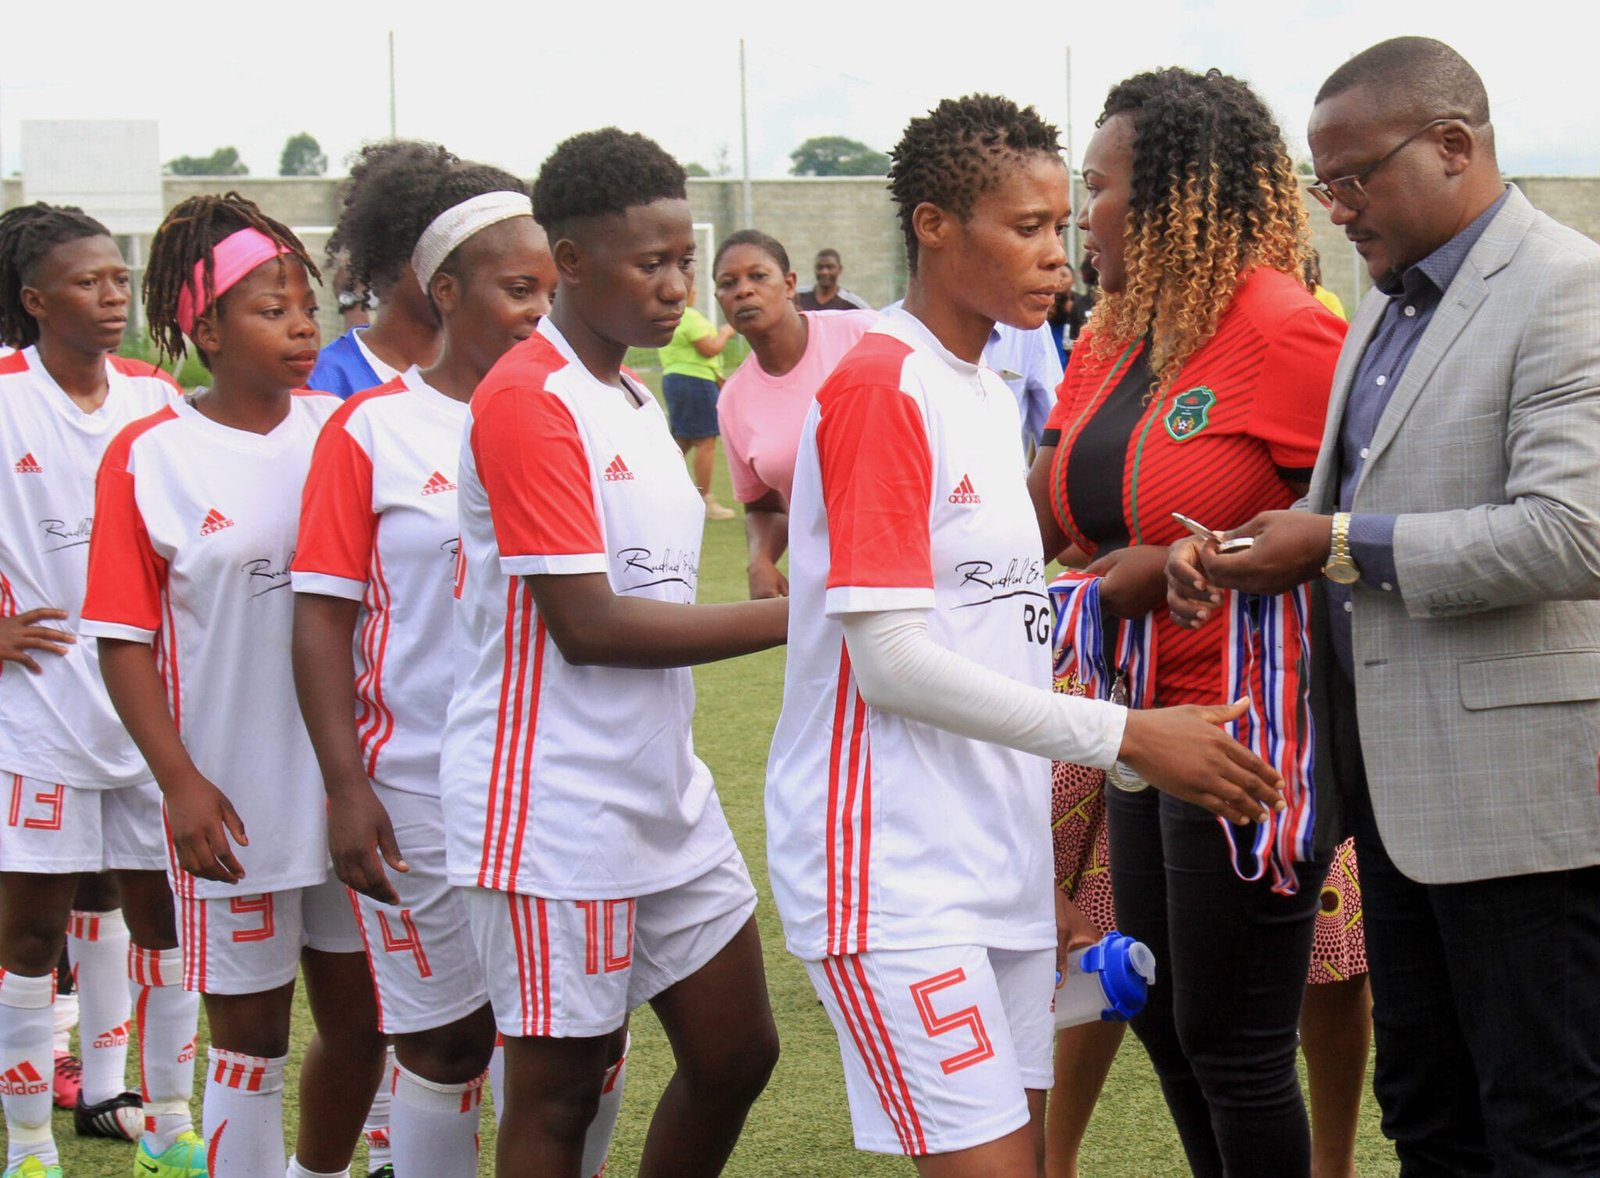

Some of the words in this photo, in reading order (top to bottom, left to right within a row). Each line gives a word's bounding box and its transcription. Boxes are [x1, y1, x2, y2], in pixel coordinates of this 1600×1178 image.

[604, 471, 635, 481] adidas
[420, 483, 458, 496] adidas
[949, 493, 981, 504] adidas
[200, 519, 235, 536] adidas
[1024, 604, 1050, 645] RG
[8, 773, 64, 831] 13
[376, 909, 432, 978] 4
[575, 897, 634, 975] 10
[909, 967, 995, 1075] 5
[93, 1033, 128, 1049] adid
[0, 1080, 48, 1096] didas
